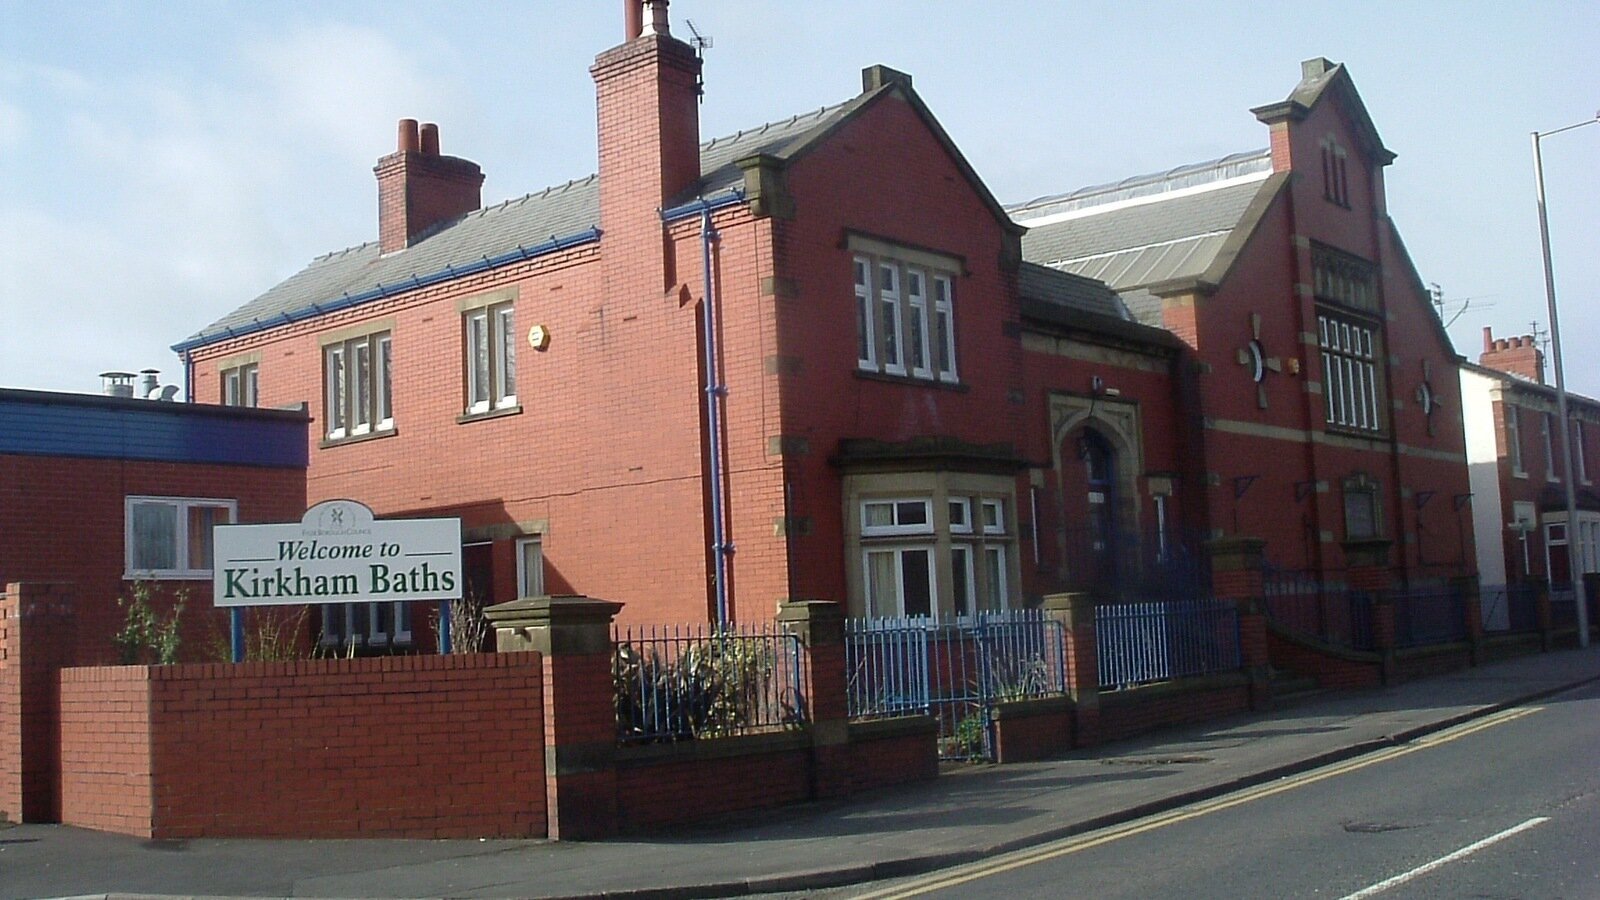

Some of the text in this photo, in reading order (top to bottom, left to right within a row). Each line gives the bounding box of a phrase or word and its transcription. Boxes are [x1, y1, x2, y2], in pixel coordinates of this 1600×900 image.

[278, 540, 400, 561] Welcome to
[224, 562, 455, 598] Kirkham Baths
